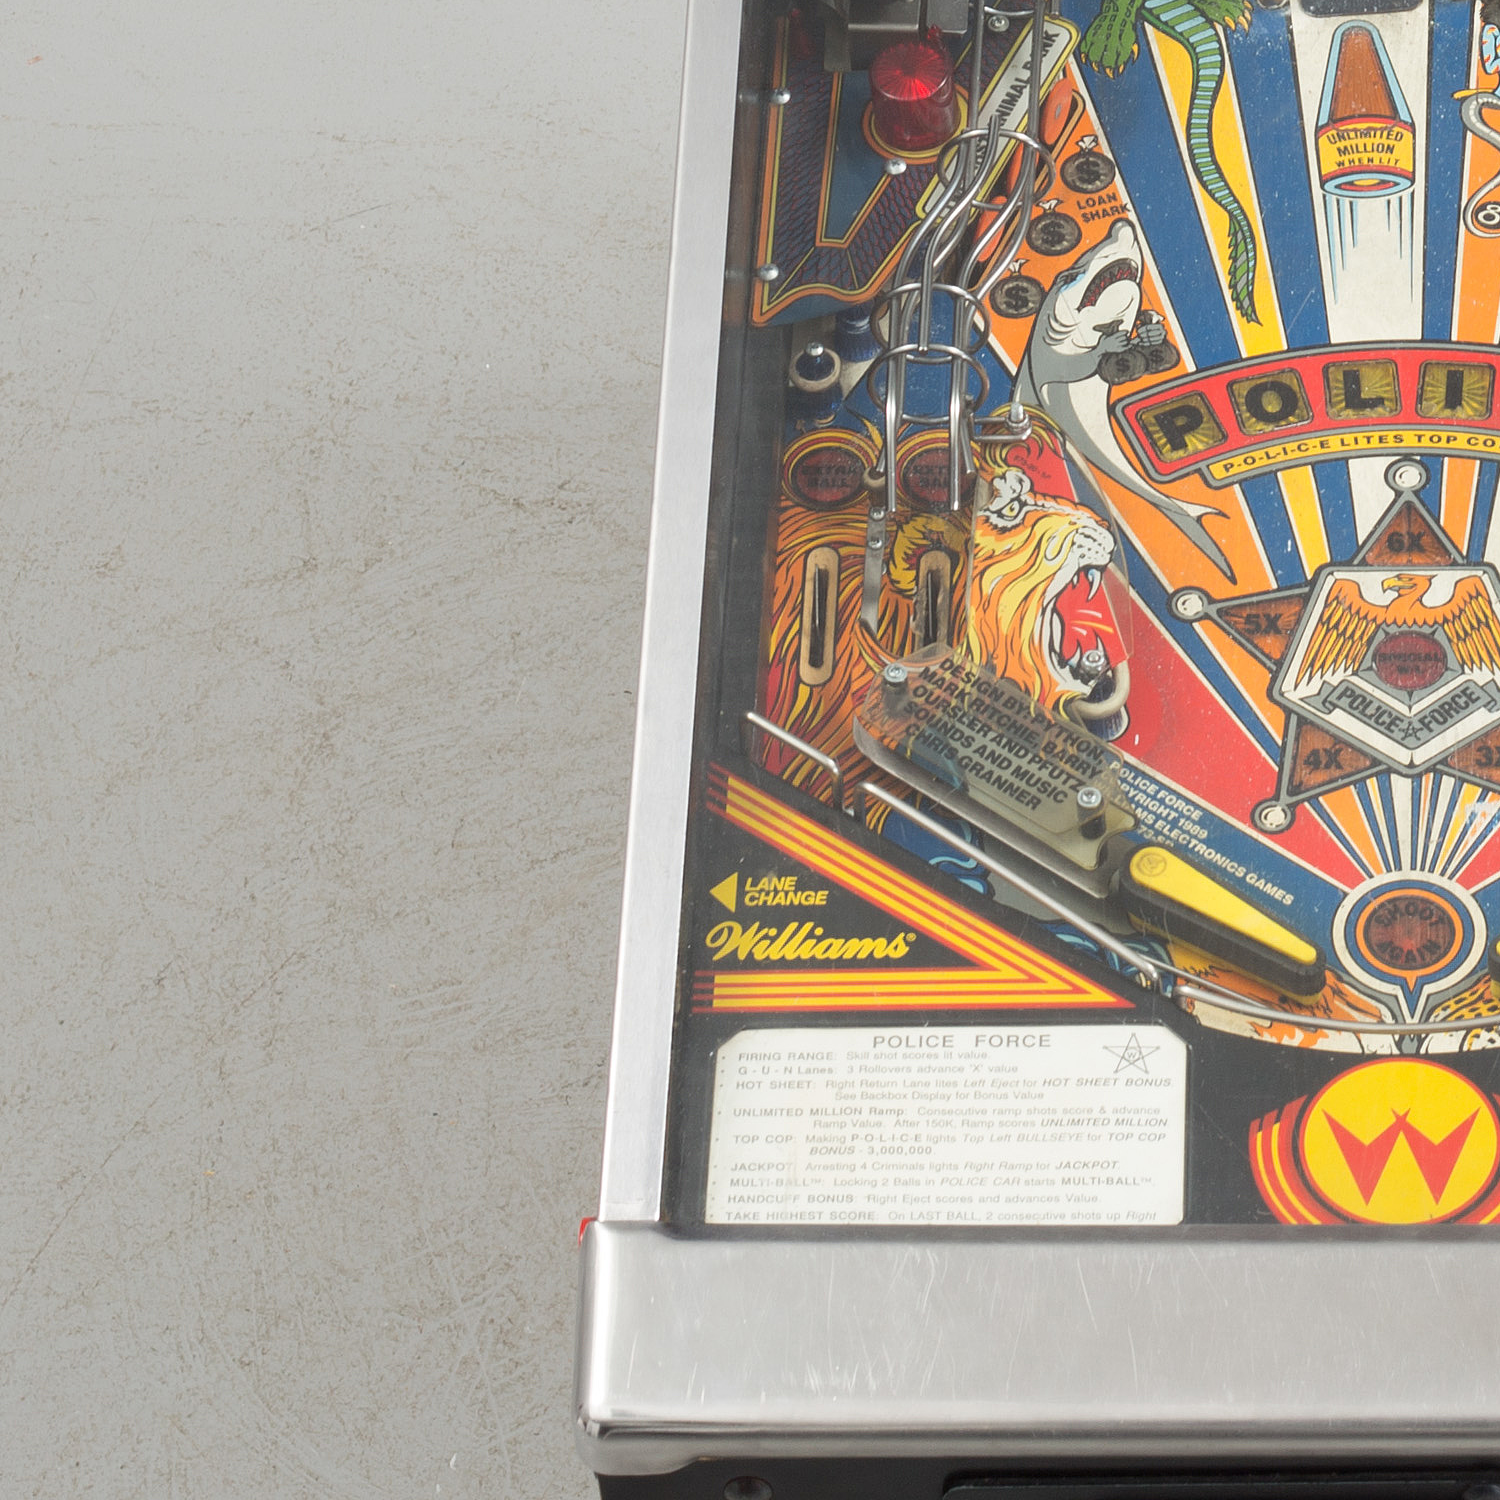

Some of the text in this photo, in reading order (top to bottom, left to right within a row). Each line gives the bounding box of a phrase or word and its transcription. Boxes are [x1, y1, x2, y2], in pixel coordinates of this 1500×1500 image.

[1326, 128, 1404, 146] UNLIMITED
[1336, 143, 1396, 158] MILLION
[1335, 156, 1401, 168] WHEN LIT
[1077, 192, 1118, 211] LOAN
[1081, 202, 1131, 224] SHARK
[1222, 438, 1330, 474] P-O-L-I-C-E
[1340, 433, 1405, 447] LITES
[1414, 433, 1458, 445] TOP
[1386, 531, 1427, 554] 6X
[1243, 613, 1283, 635] 5X
[938, 658, 1105, 766] DESIGN BY: PYTHON,
[1335, 686, 1482, 734] POLICE FORCE
[918, 666, 972, 707] MARK
[1041, 740, 1105, 781] BARRY
[912, 684, 1086, 793] OURSLER AND PFUTZ
[903, 701, 1069, 805] SOUNDS AND MUSIC
[1303, 747, 1345, 770] 4X
[905, 723, 1043, 812] CHRIS GRANNER
[1109, 759, 1159, 797] POLICE
[1156, 789, 1204, 822] FORCE
[1177, 817, 1209, 840] 1989
[1153, 819, 1247, 879] ELECTRONICS
[1245, 872, 1296, 906] GAMES
[744, 876, 798, 892] LANE
[744, 890, 829, 906] CHANGE
[873, 1033, 1052, 1049] POLICE FORCE
[738, 1052, 782, 1062] FIRING
[736, 1077, 1172, 1090] HOT HOT SHEET BONUS
[733, 1106, 863, 1118] UNLIMITED MILLION
[1040, 1117, 1169, 1128] UNLIMITED MILLION
[733, 1132, 1167, 1145] TOP TOP COP
[809, 1145, 857, 1156] BONUS
[725, 1211, 760, 1221] TAKE
